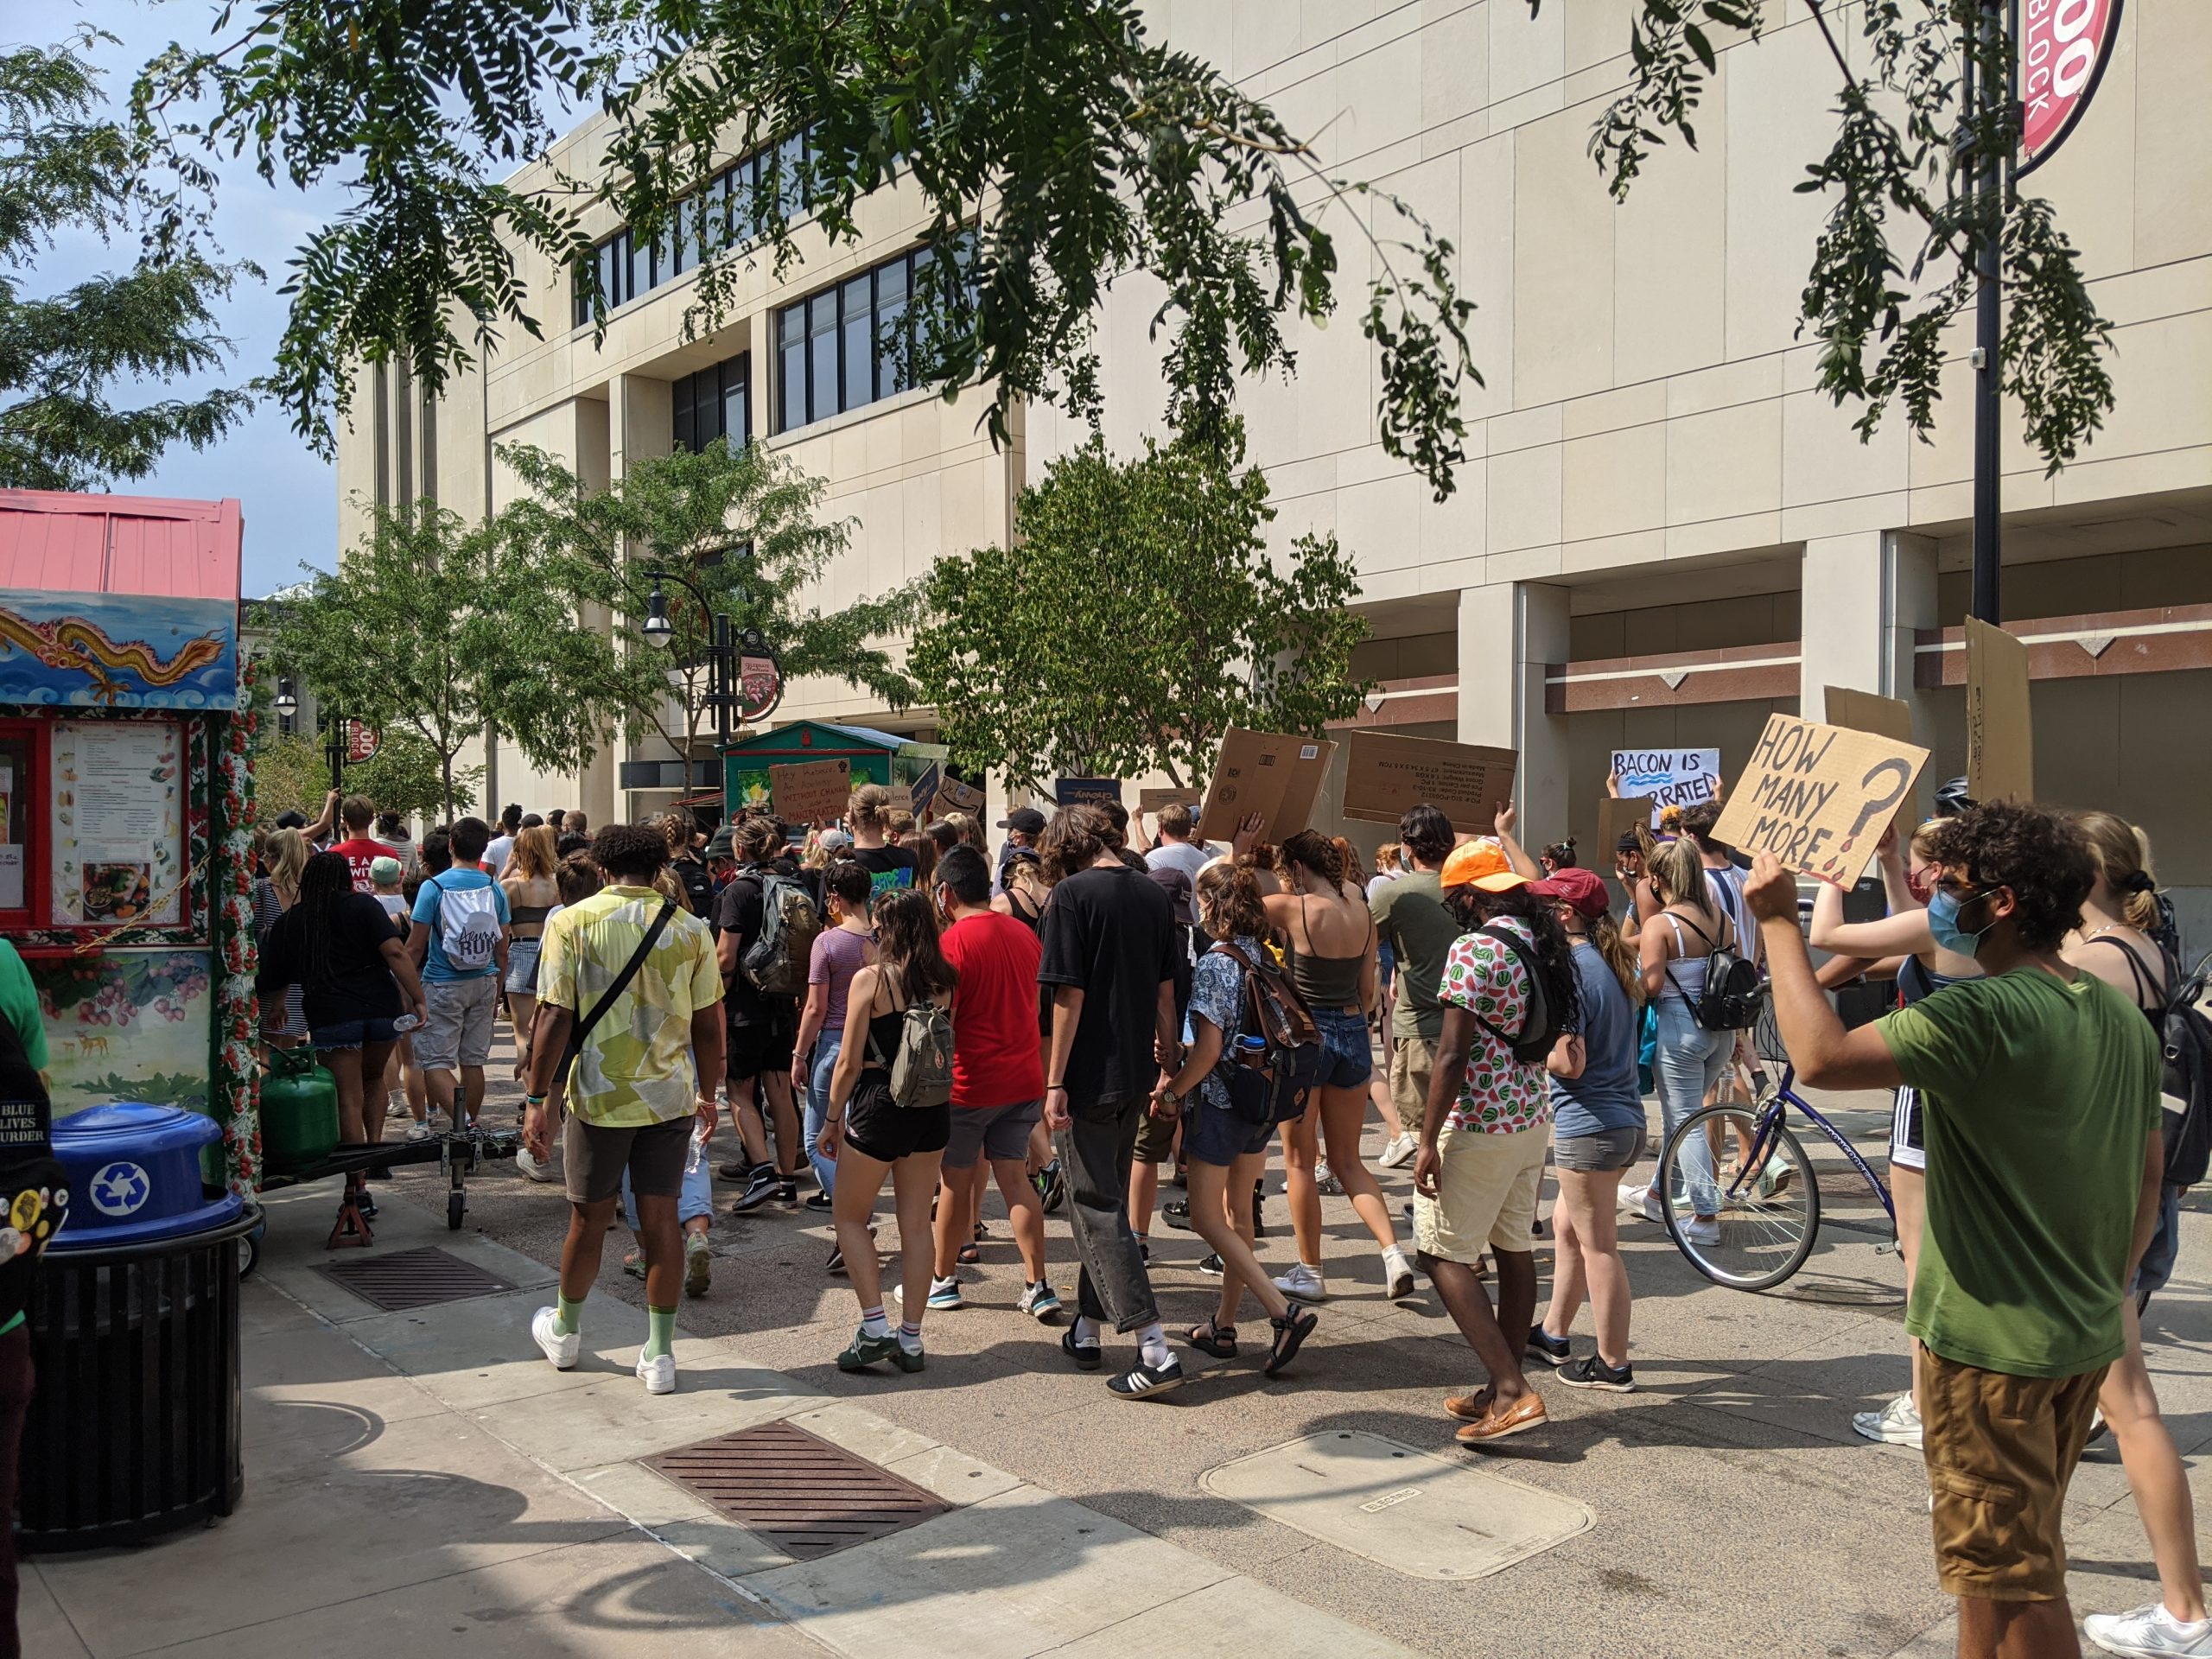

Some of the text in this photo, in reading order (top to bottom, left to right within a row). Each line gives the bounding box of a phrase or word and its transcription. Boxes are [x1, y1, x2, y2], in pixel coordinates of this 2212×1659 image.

[2028, 0, 2050, 122] BLOCK
[351, 727, 359, 754] BLOCK
[359, 725, 374, 754] 00
[1752, 719, 1838, 774] HOW
[1614, 753, 1700, 776] BACON IS
[782, 785, 847, 802] WITHOUT CHANGE
[1074, 790, 1114, 800] chewy
[1636, 772, 1717, 812] RRATED
[1751, 773, 1840, 825] MANY
[1746, 816, 1833, 872] MORE
[0, 1117, 36, 1128] LIVES
[2, 1104, 35, 1116] BLUE
[0, 1130, 44, 1142] URDER
[1824, 1125, 1871, 1178] MONGOOSE
[1365, 1489, 1415, 1510] ELECTRIC
